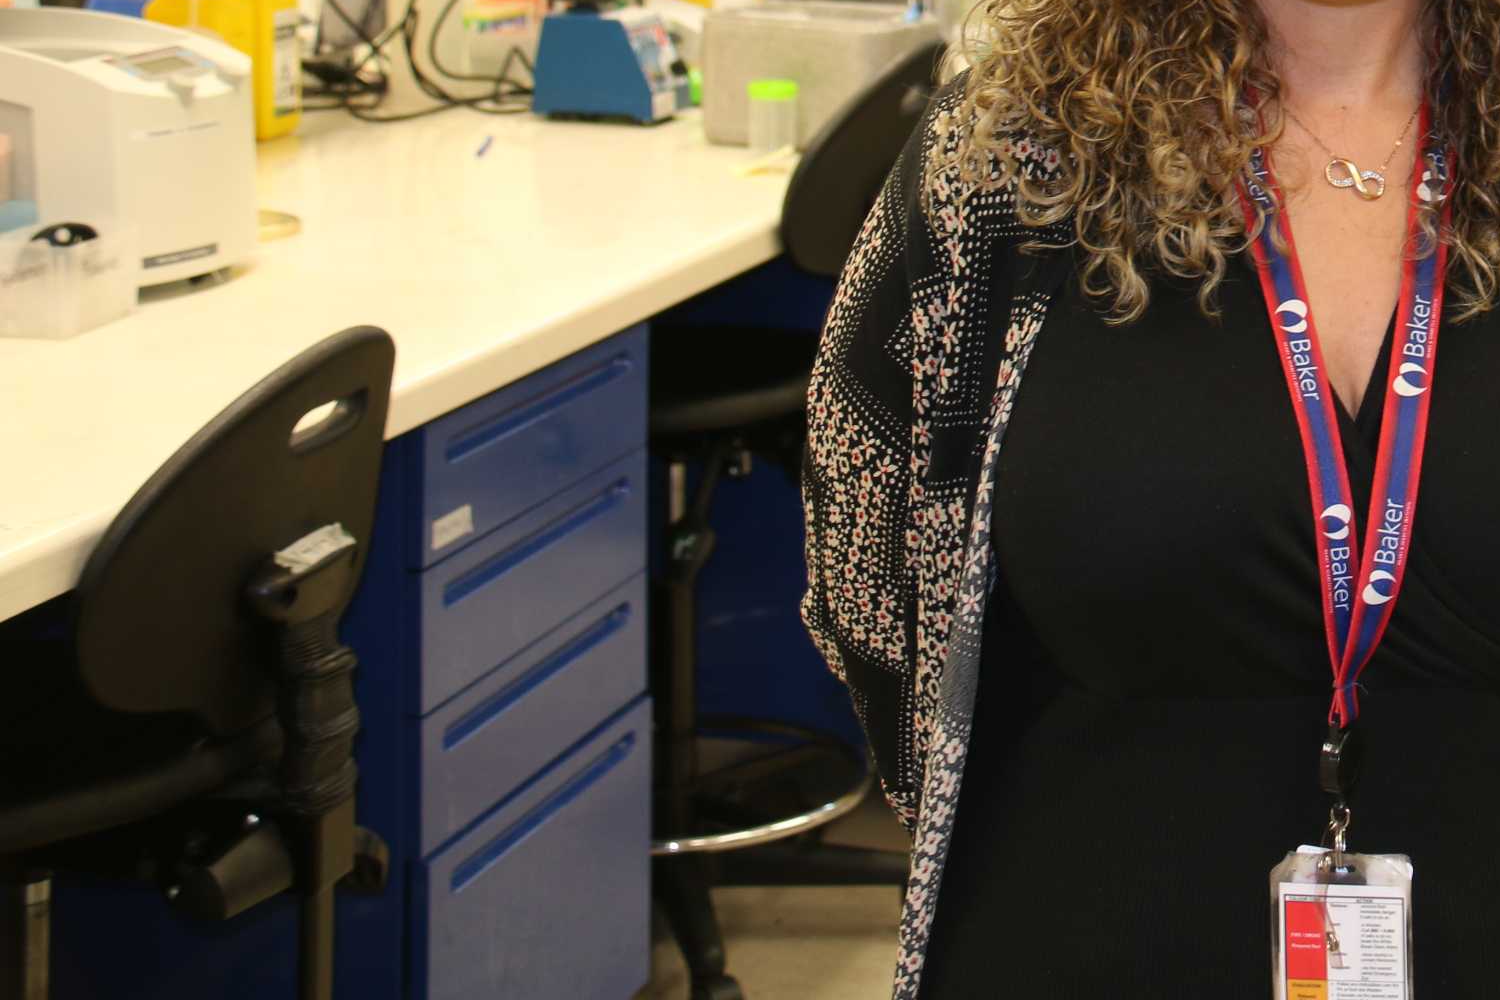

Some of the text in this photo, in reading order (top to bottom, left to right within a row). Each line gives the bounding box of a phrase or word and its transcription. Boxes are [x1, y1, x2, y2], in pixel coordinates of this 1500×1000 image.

[1403, 295, 1432, 358] Baker
[1289, 338, 1320, 401] Baker
[1373, 498, 1404, 564] Baker
[1330, 547, 1354, 612] Baker
